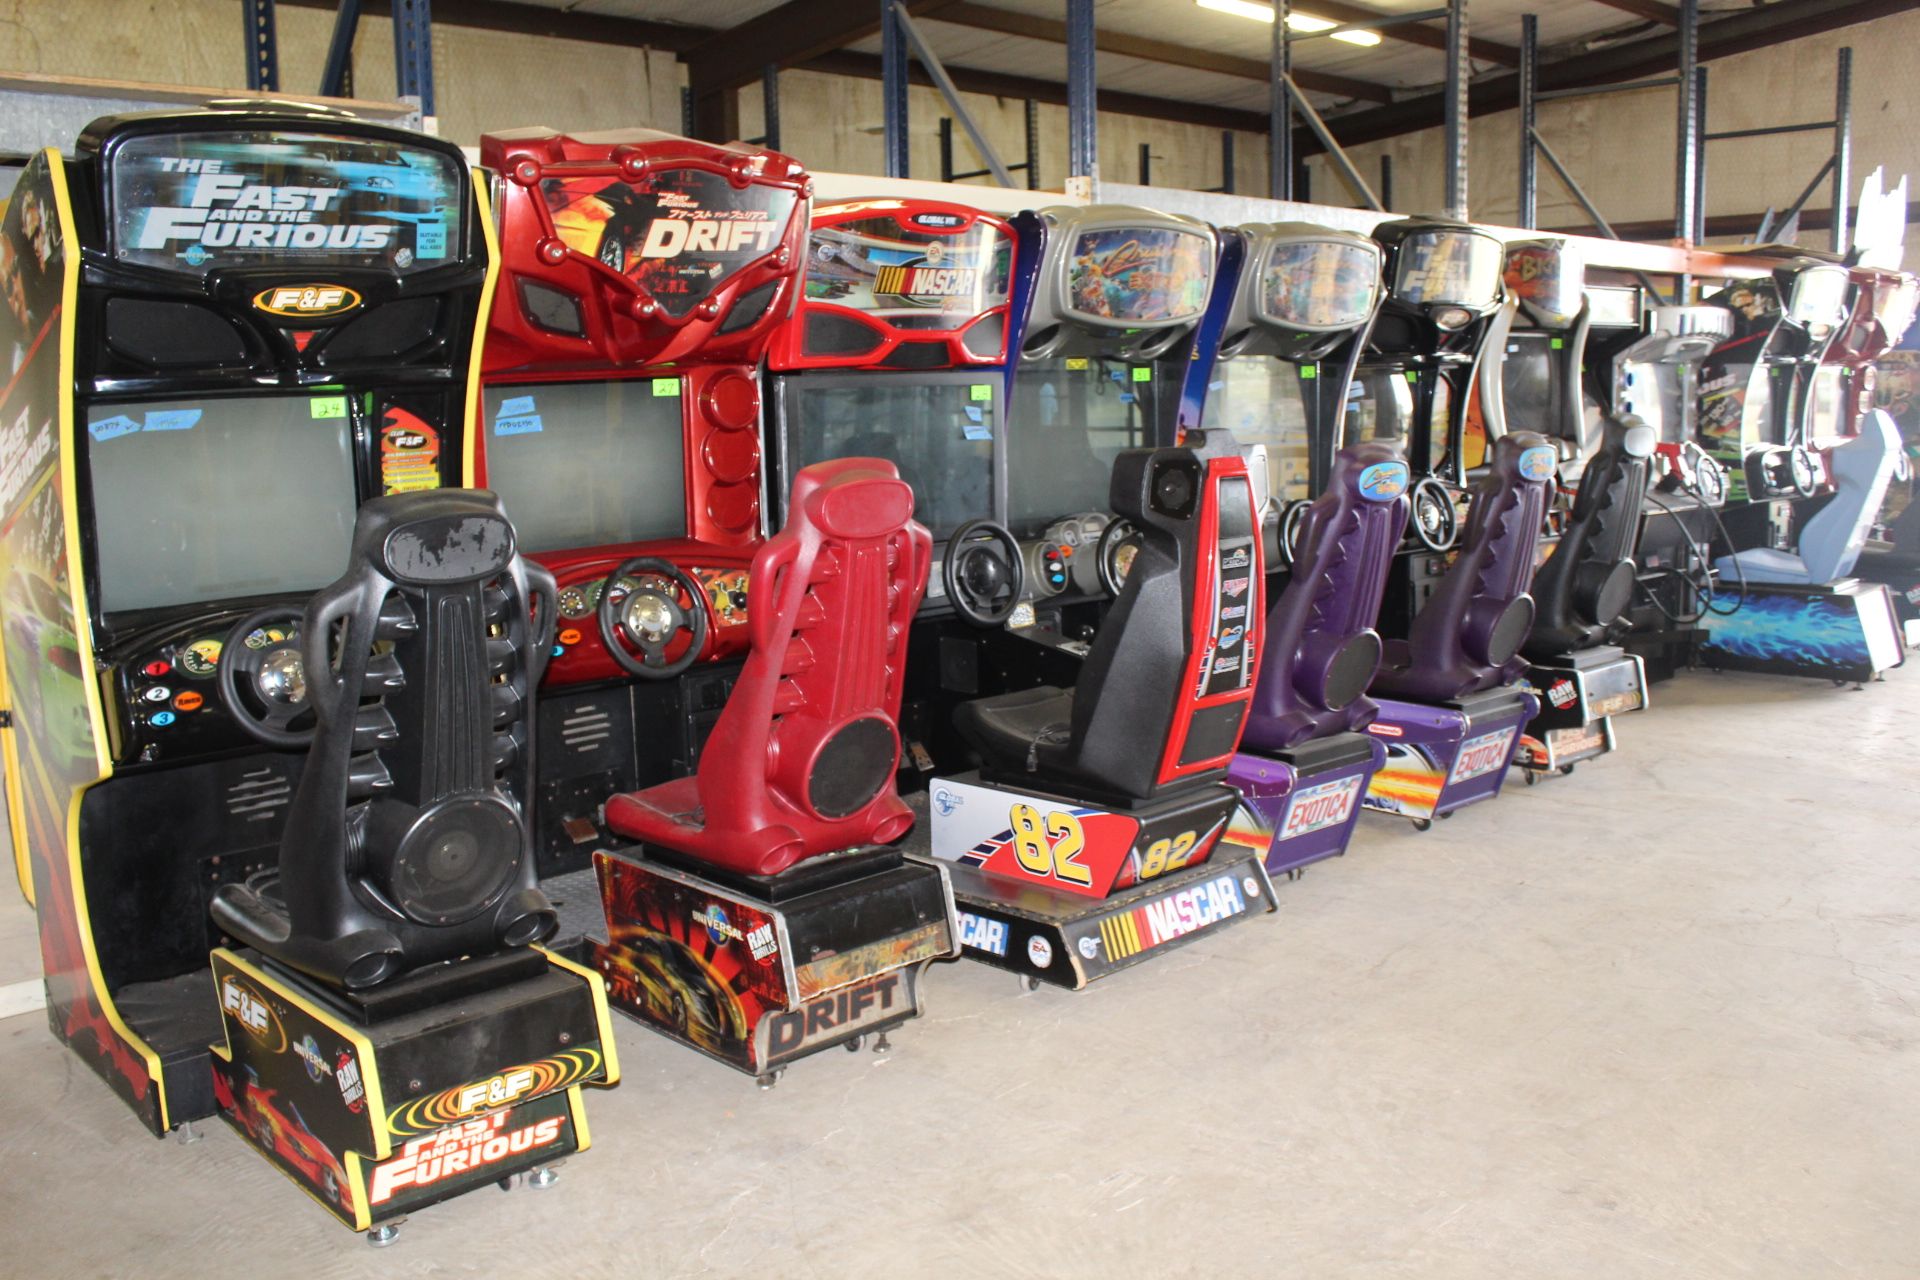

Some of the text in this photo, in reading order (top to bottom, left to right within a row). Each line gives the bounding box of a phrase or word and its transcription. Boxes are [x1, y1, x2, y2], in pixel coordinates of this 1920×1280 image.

[161, 158, 222, 174] THE
[191, 174, 339, 211] FAST
[139, 207, 394, 249] FURIOUS
[208, 209, 313, 223] AND THE
[918, 214, 944, 225] GLOBAL
[641, 219, 777, 258] DRIFT
[271, 290, 343, 309] F&F
[911, 268, 976, 296] NASCAR
[396, 436, 424, 448] F&F
[154, 689, 163, 698] 2
[159, 713, 169, 724] 3
[1456, 742, 1504, 775] EXOTICA
[1288, 791, 1348, 830] EXOTICA
[1009, 803, 1091, 887] 82
[1141, 830, 1197, 879] 82
[692, 910, 744, 941] UNIVERSAL
[1145, 875, 1242, 944] NASCAR
[746, 923, 774, 948] RAW
[224, 982, 269, 1034] F&F
[770, 975, 899, 1050] DRIFT
[292, 1041, 333, 1077] UNIVERSAL
[337, 1058, 361, 1094] RAW
[458, 1069, 534, 1115] F&F
[371, 1118, 560, 1204] FURIOUS
[419, 1130, 496, 1162] AND THE
